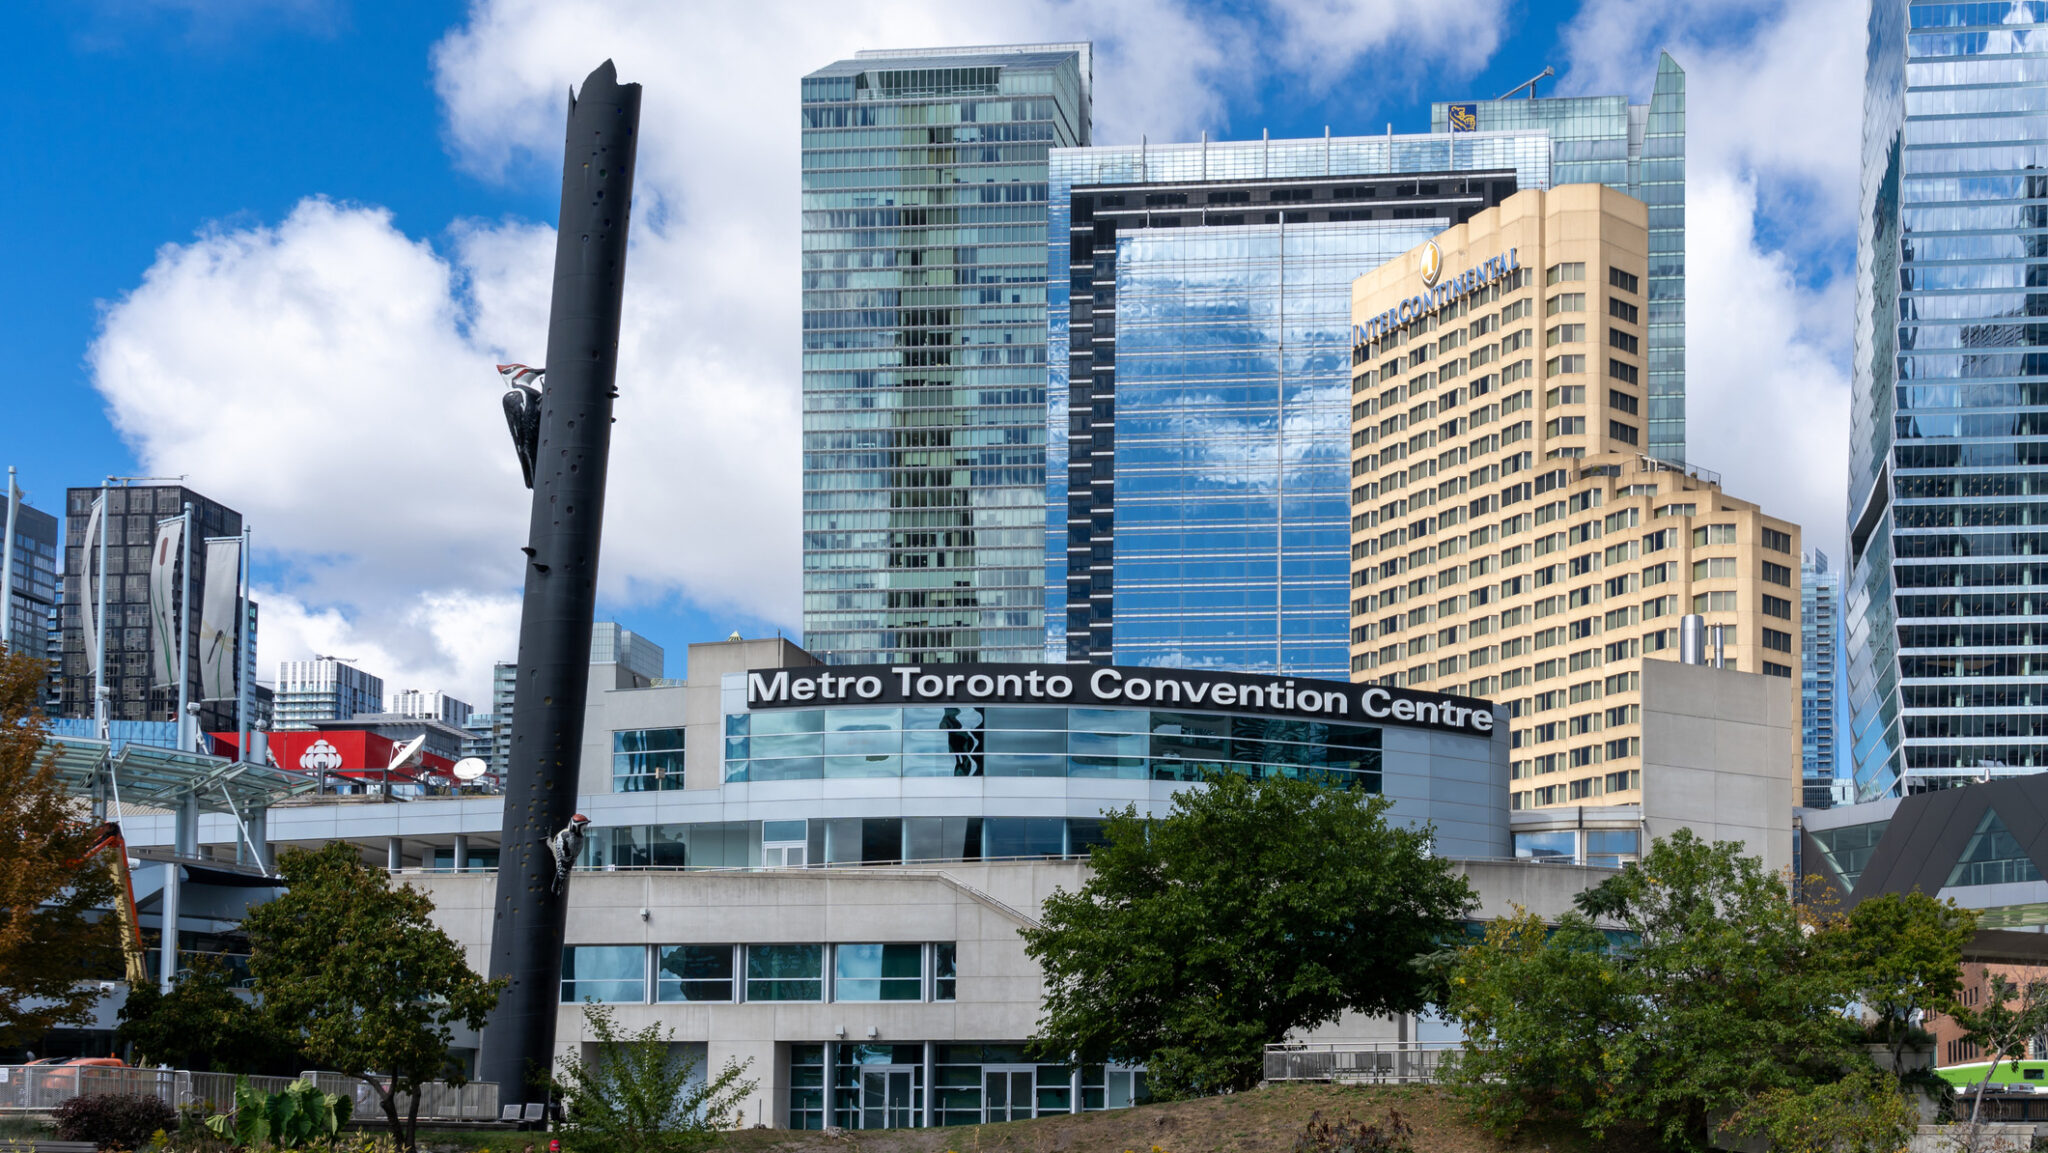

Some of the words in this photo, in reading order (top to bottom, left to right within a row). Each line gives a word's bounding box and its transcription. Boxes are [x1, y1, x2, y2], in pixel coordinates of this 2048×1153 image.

[1352, 247, 1520, 348] INTERCONTINENTAL
[748, 670, 883, 703] Metro
[892, 666, 1074, 698] Toronto
[1090, 668, 1348, 715] Convention
[1361, 687, 1494, 732] Centre
